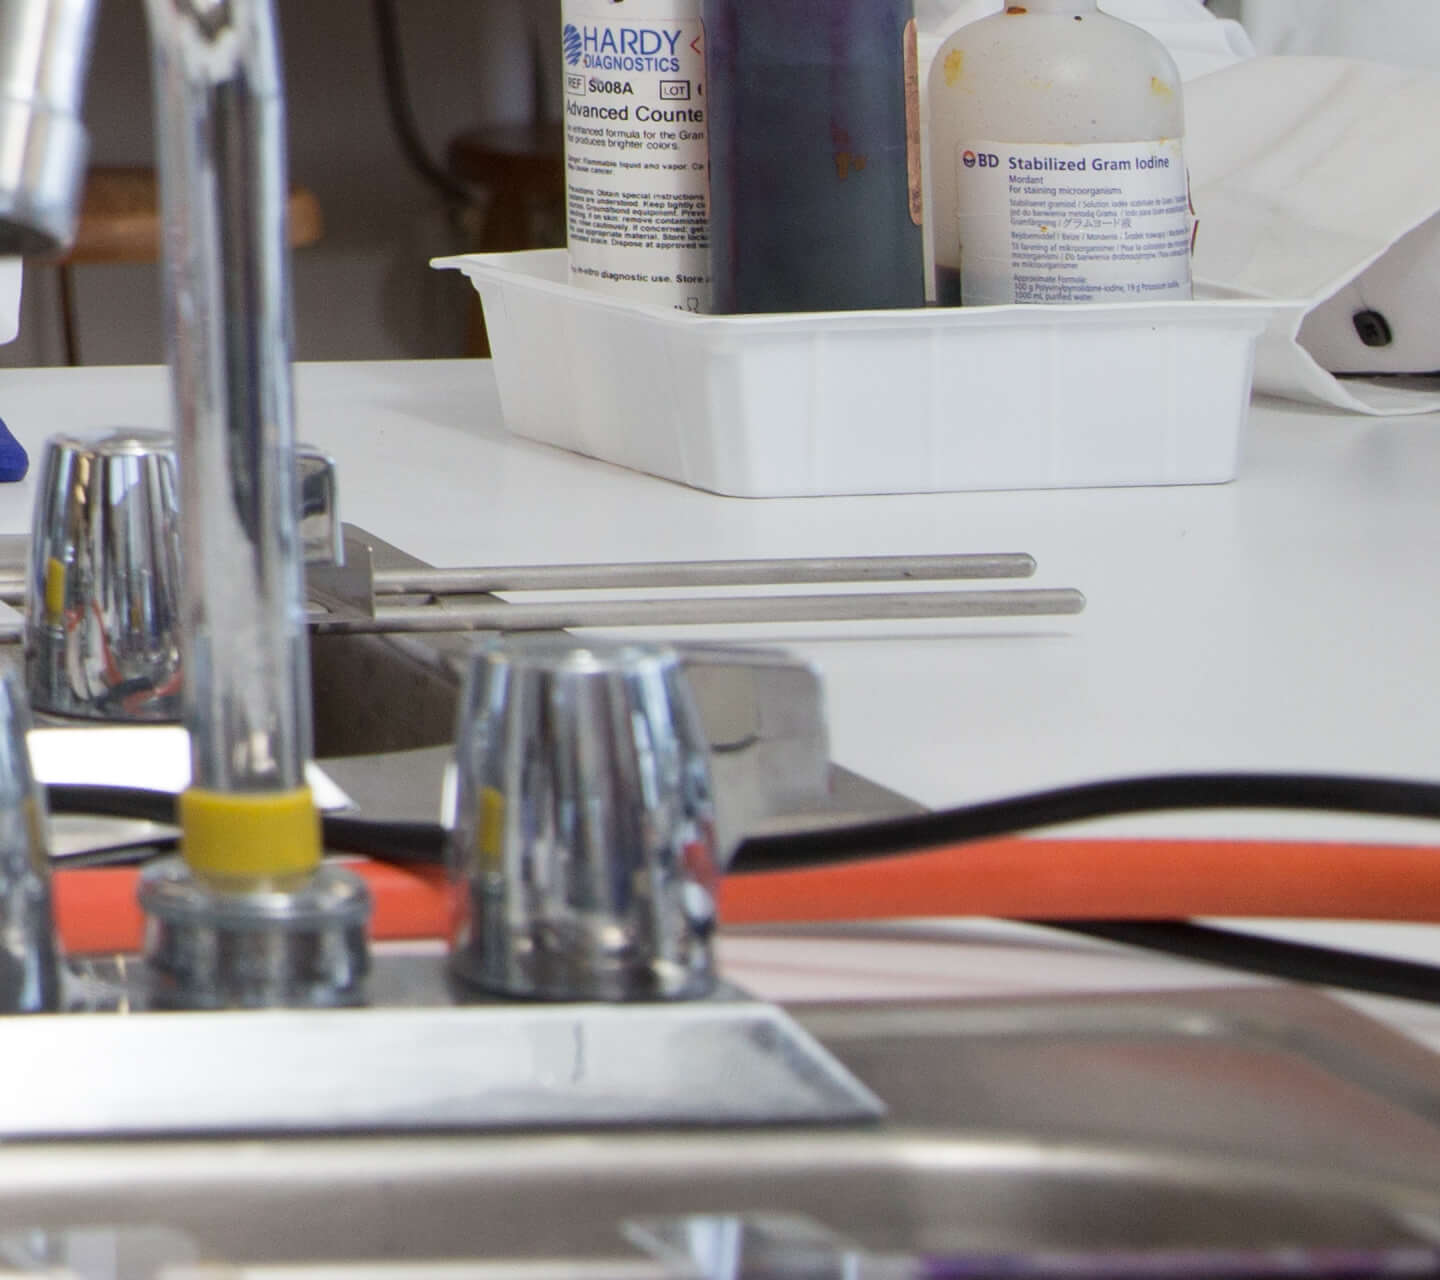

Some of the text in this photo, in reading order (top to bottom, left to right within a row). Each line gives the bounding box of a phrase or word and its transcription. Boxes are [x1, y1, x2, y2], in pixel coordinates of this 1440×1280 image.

[583, 26, 682, 55] HARDY
[584, 54, 680, 72] DIAGNOSTICS
[589, 80, 634, 95] S008A
[664, 86, 685, 96] LOT
[567, 99, 629, 121] Advanced
[606, 129, 640, 140] formula
[643, 130, 656, 140] for
[660, 131, 676, 140] the
[608, 138, 642, 150] brighter
[978, 154, 1169, 171] BD Stabilized Gram Iodine
[1009, 175, 1044, 184] Mordant
[1009, 184, 1122, 197] For staining microorganisms
[601, 271, 648, 282] diagnostic
[676, 274, 704, 284] Store
